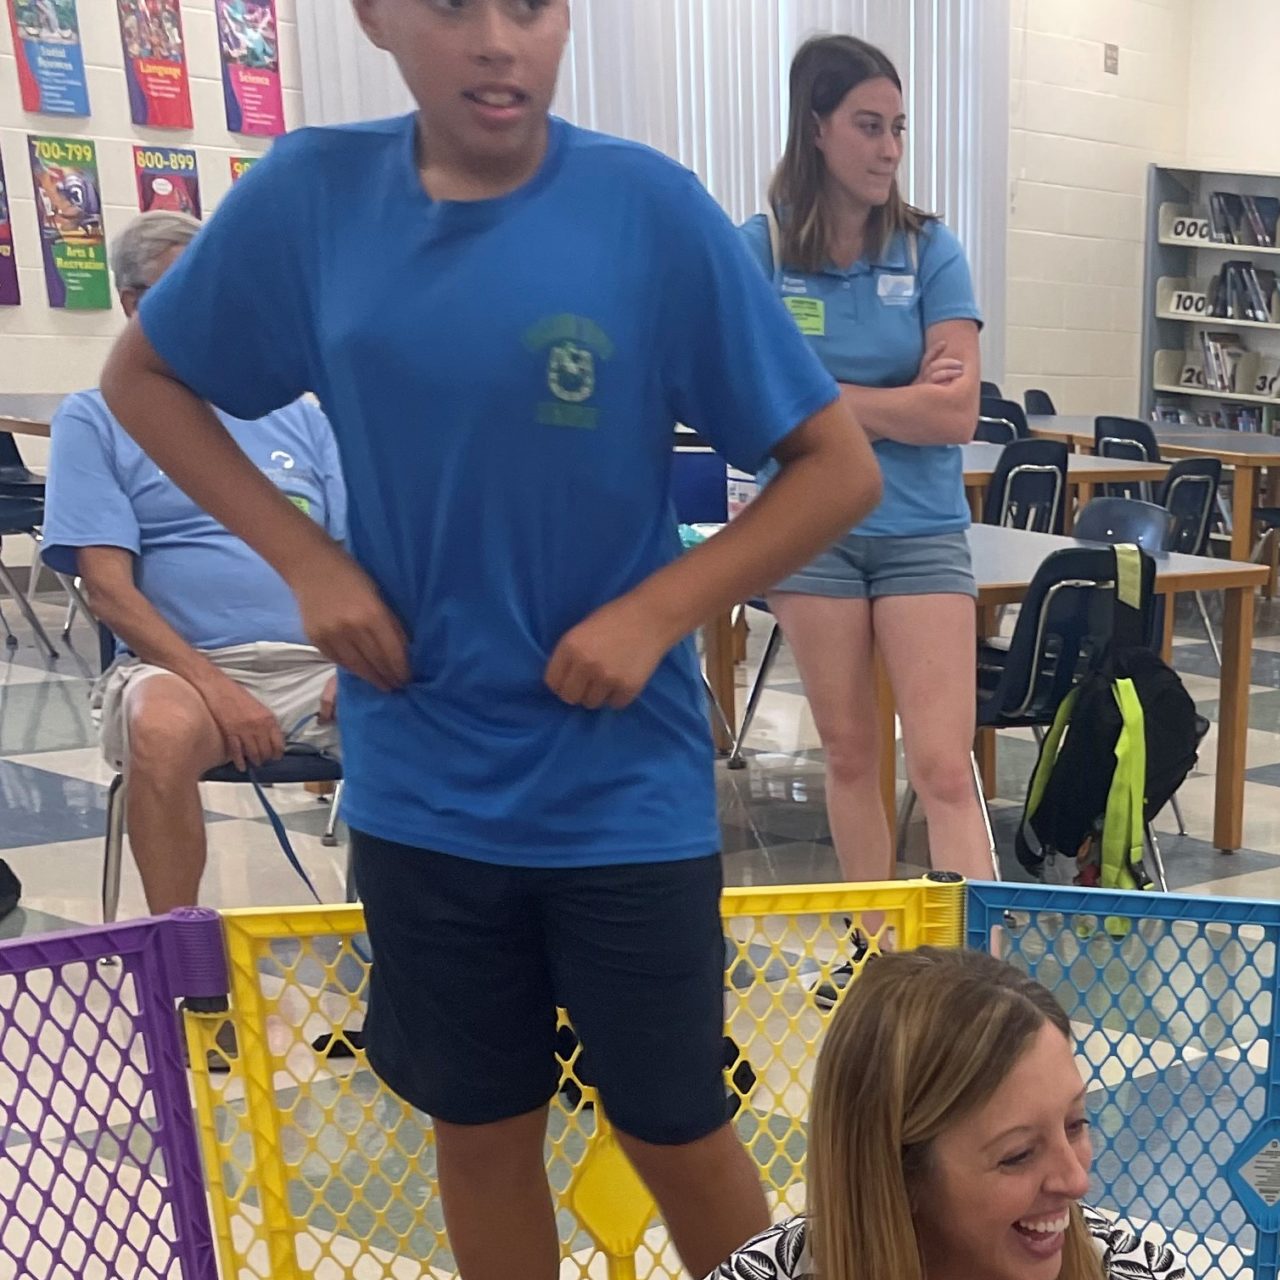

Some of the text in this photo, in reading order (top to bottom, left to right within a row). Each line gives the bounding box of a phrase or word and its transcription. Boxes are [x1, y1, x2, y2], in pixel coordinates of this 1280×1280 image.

[238, 71, 270, 86] Science
[32, 141, 93, 162] 700-799
[136, 150, 195, 170] 800-899
[1174, 220, 1209, 239] 000
[1175, 294, 1205, 312] 100
